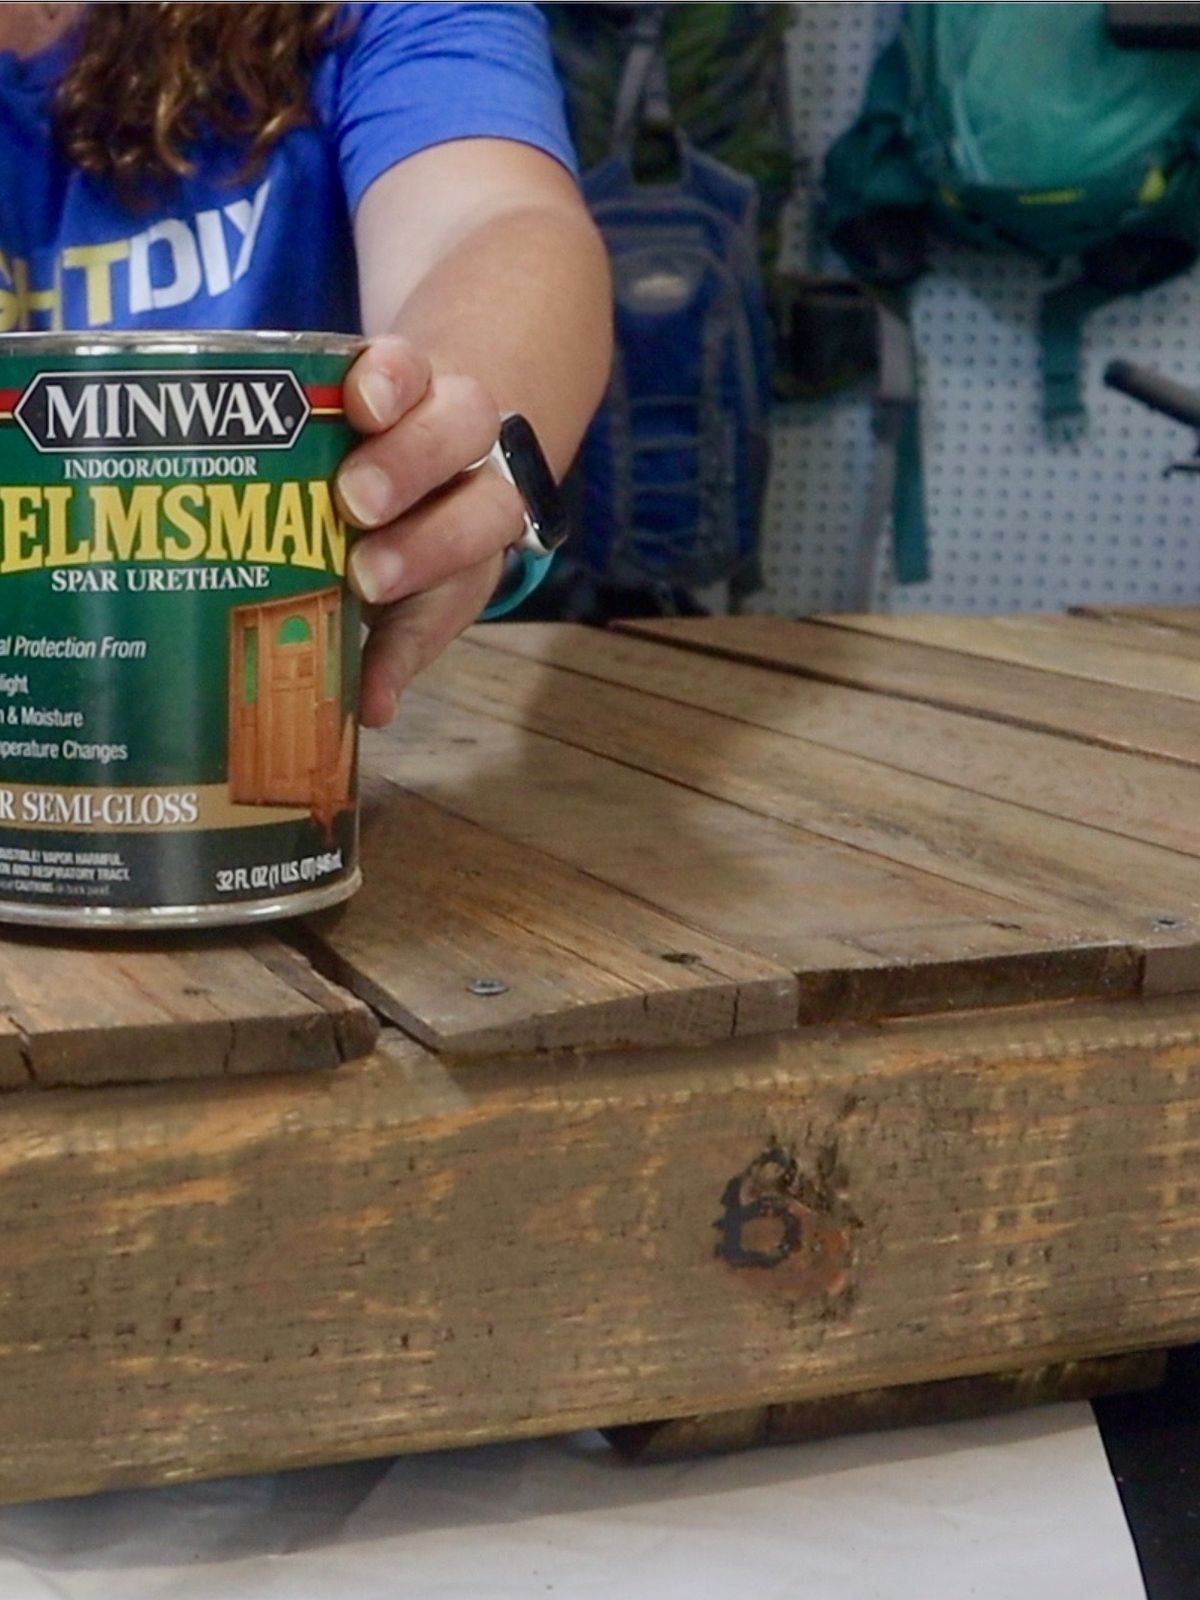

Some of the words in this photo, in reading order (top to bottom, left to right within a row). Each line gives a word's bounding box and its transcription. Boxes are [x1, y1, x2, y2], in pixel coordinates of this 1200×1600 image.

[45, 381, 288, 439] MINWAX
[63, 456, 257, 479] INDOOR/OUTDOOR
[52, 568, 120, 592] SPAR
[127, 566, 271, 592] URETHANE
[13, 635, 96, 658] Protection
[100, 636, 147, 658] From
[6, 706, 19, 725] &
[21, 706, 84, 728] Moisture
[62, 740, 128, 764] Changes
[22, 790, 198, 825] SEMI-GLOSS
